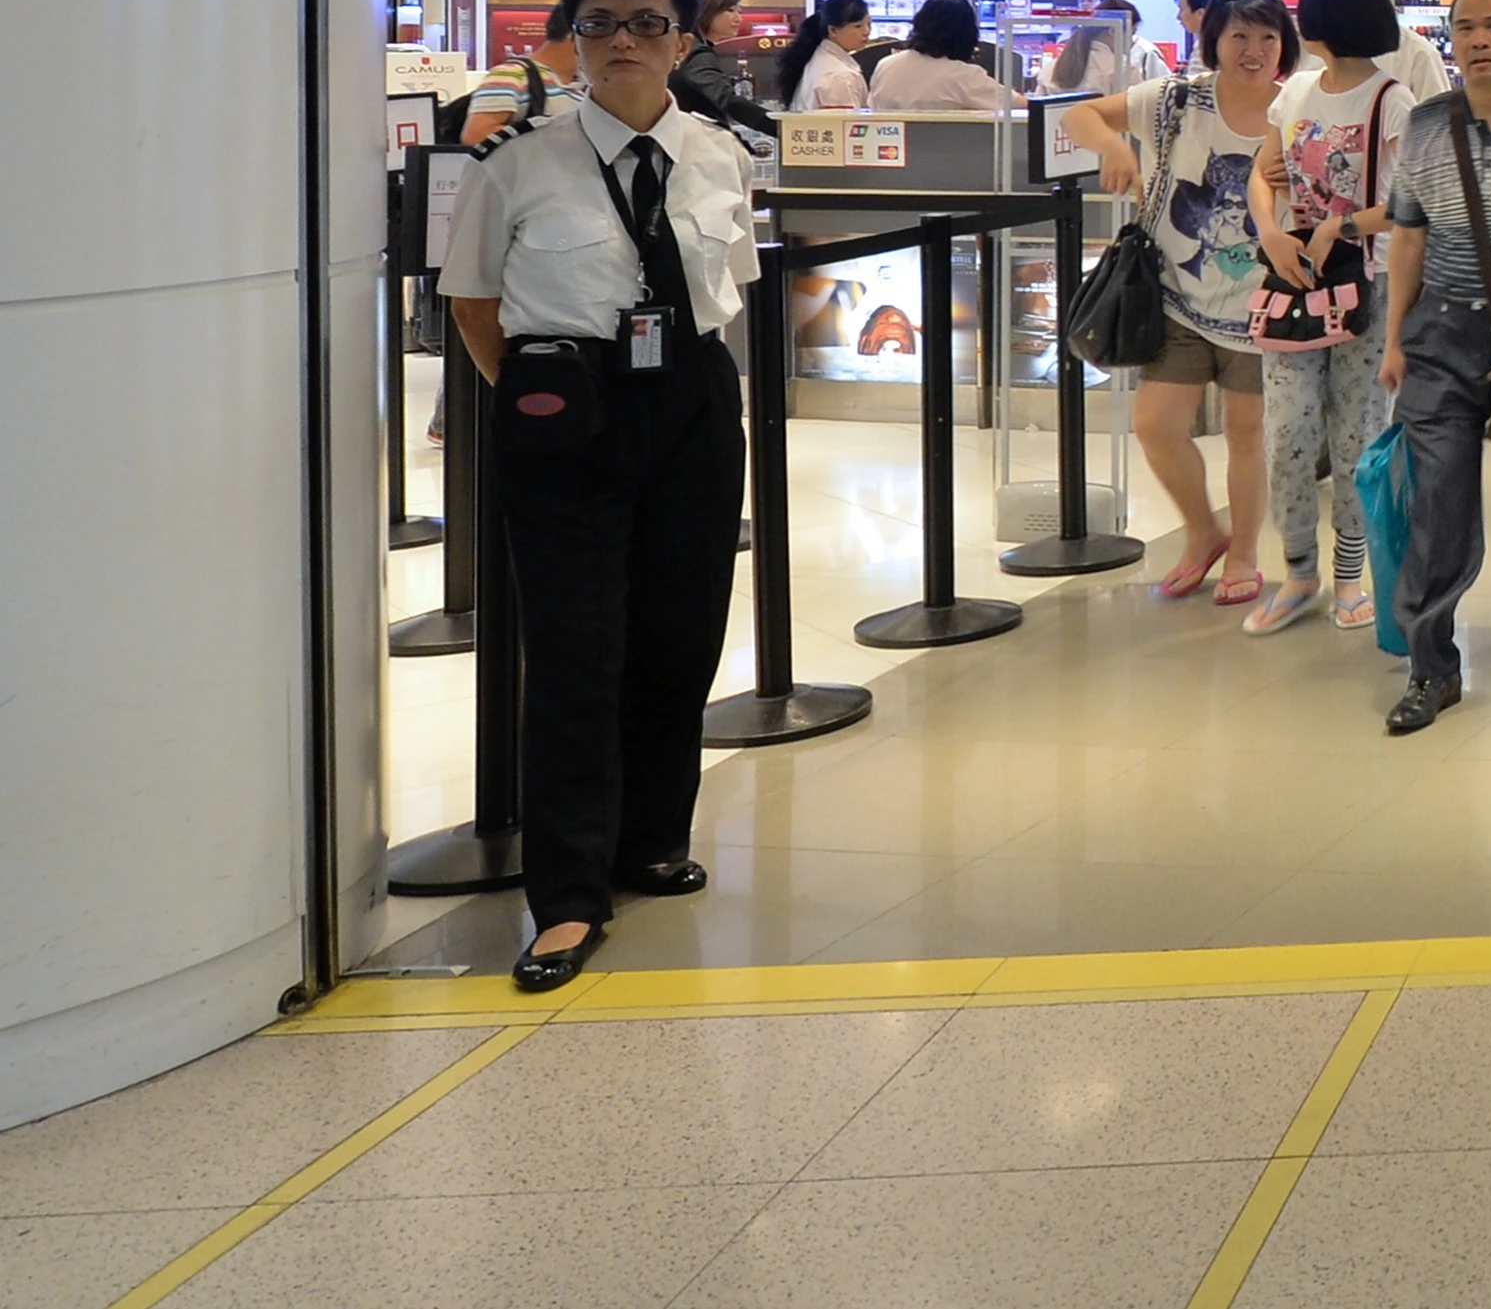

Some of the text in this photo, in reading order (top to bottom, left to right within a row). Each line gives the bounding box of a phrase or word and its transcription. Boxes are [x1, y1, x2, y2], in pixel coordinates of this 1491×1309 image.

[395, 65, 455, 75] CAMUS
[876, 126, 899, 136] VISA
[791, 146, 835, 156] CASHIER
